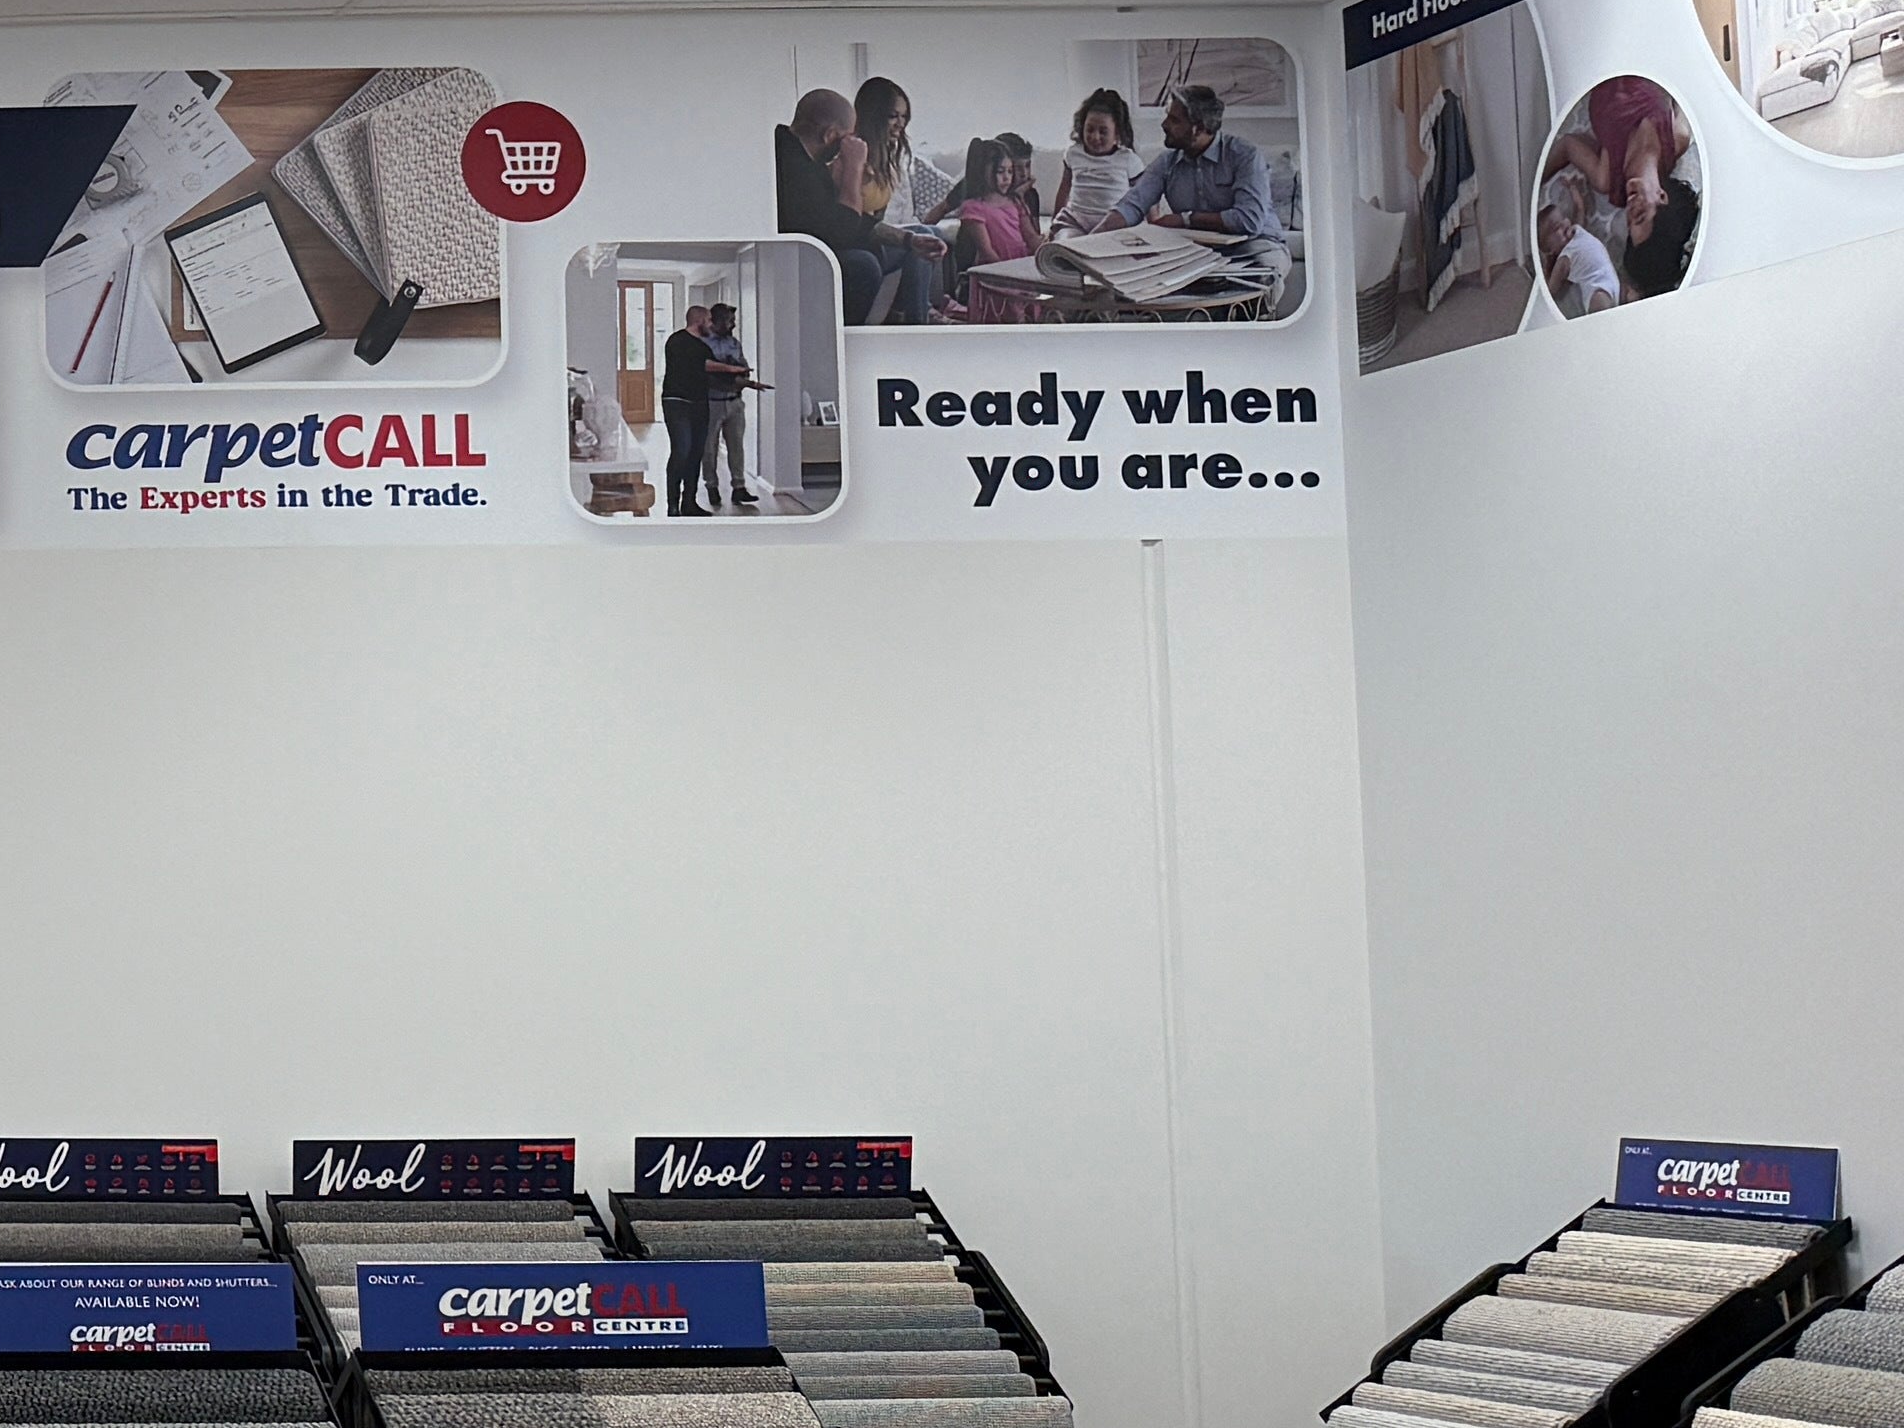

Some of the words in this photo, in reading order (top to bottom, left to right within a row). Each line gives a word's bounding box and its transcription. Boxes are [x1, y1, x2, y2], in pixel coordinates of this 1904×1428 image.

[877, 373, 1103, 442] Ready
[1123, 371, 1317, 424] when
[967, 452, 1099, 508] you
[1121, 450, 1321, 491] are...
[67, 487, 127, 510] The
[140, 486, 266, 514] Experts
[276, 484, 308, 508] in
[322, 483, 372, 507] the
[386, 482, 487, 507] Trade.
[304, 1142, 426, 1196] Wool
[643, 1141, 766, 1193] Wool
[1658, 1186, 1732, 1198] FLOOR
[187, 1278, 211, 1287] AND
[368, 1274, 399, 1284] ONLY
[75, 1296, 150, 1308] AVAILABLE
[156, 1296, 200, 1308] NOW!
[442, 1321, 587, 1333] FLOOR
[594, 1320, 686, 1332] CENTRE
